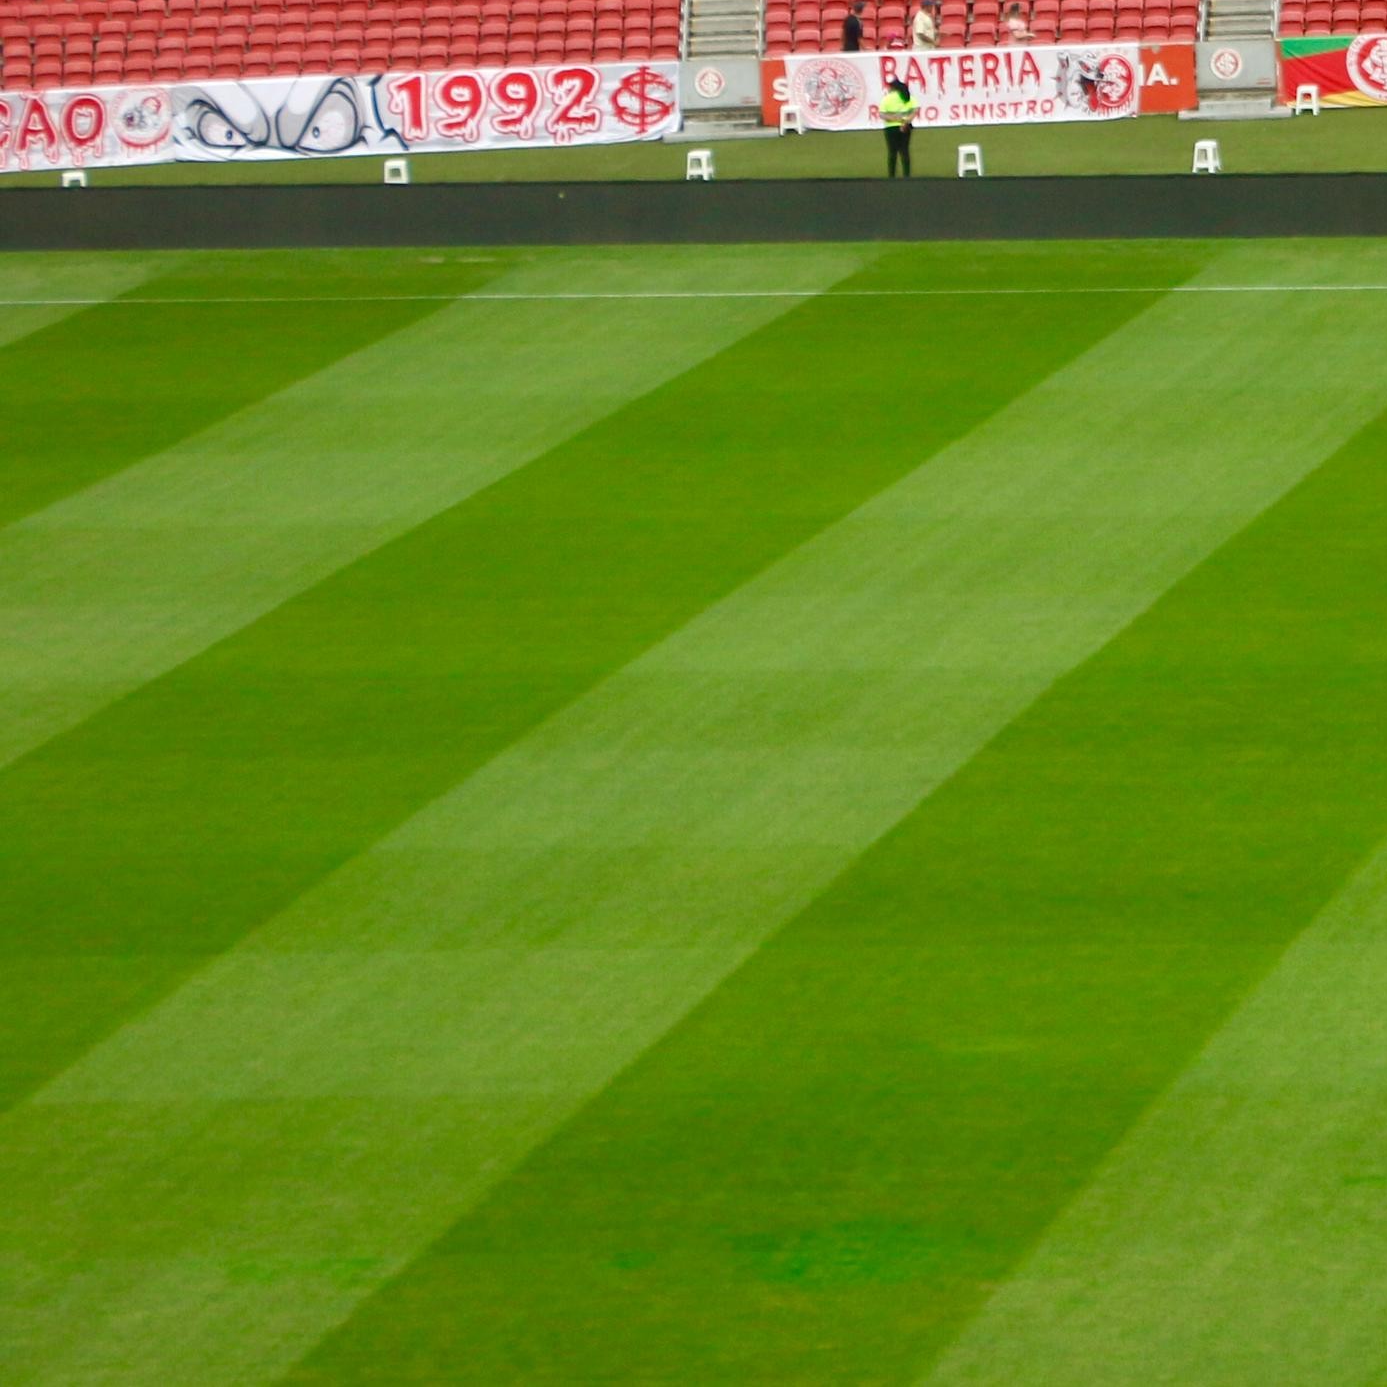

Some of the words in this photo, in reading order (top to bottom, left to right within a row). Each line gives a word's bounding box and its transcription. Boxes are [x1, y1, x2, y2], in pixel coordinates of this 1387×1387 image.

[879, 51, 1041, 93] BATERIA
[388, 65, 601, 143] 1992
[951, 99, 1054, 121] SINISTRO
